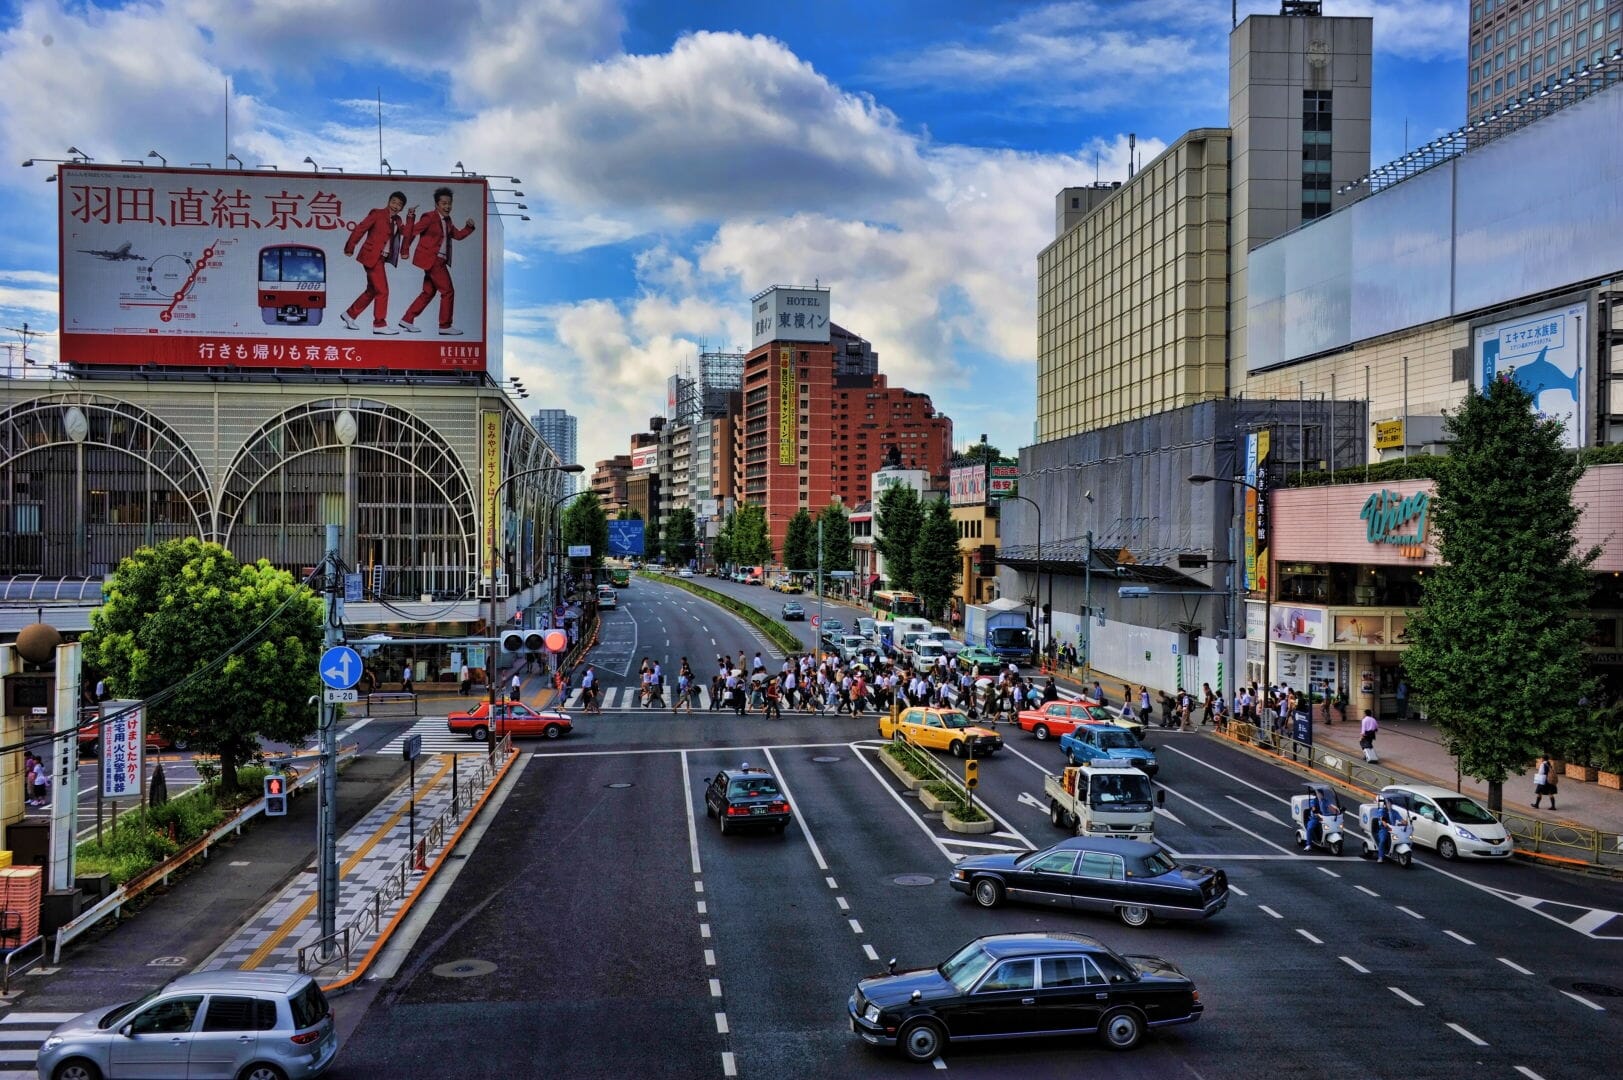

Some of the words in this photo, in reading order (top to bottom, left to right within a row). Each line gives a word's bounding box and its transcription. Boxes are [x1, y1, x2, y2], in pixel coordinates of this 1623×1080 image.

[786, 297, 820, 306] HOTEL
[778, 312, 828, 329] 東横イン
[1505, 322, 1558, 343] エキマエ水族館
[199, 343, 362, 363] 行きも帰りも京急で。
[441, 346, 480, 357] KEIKYU
